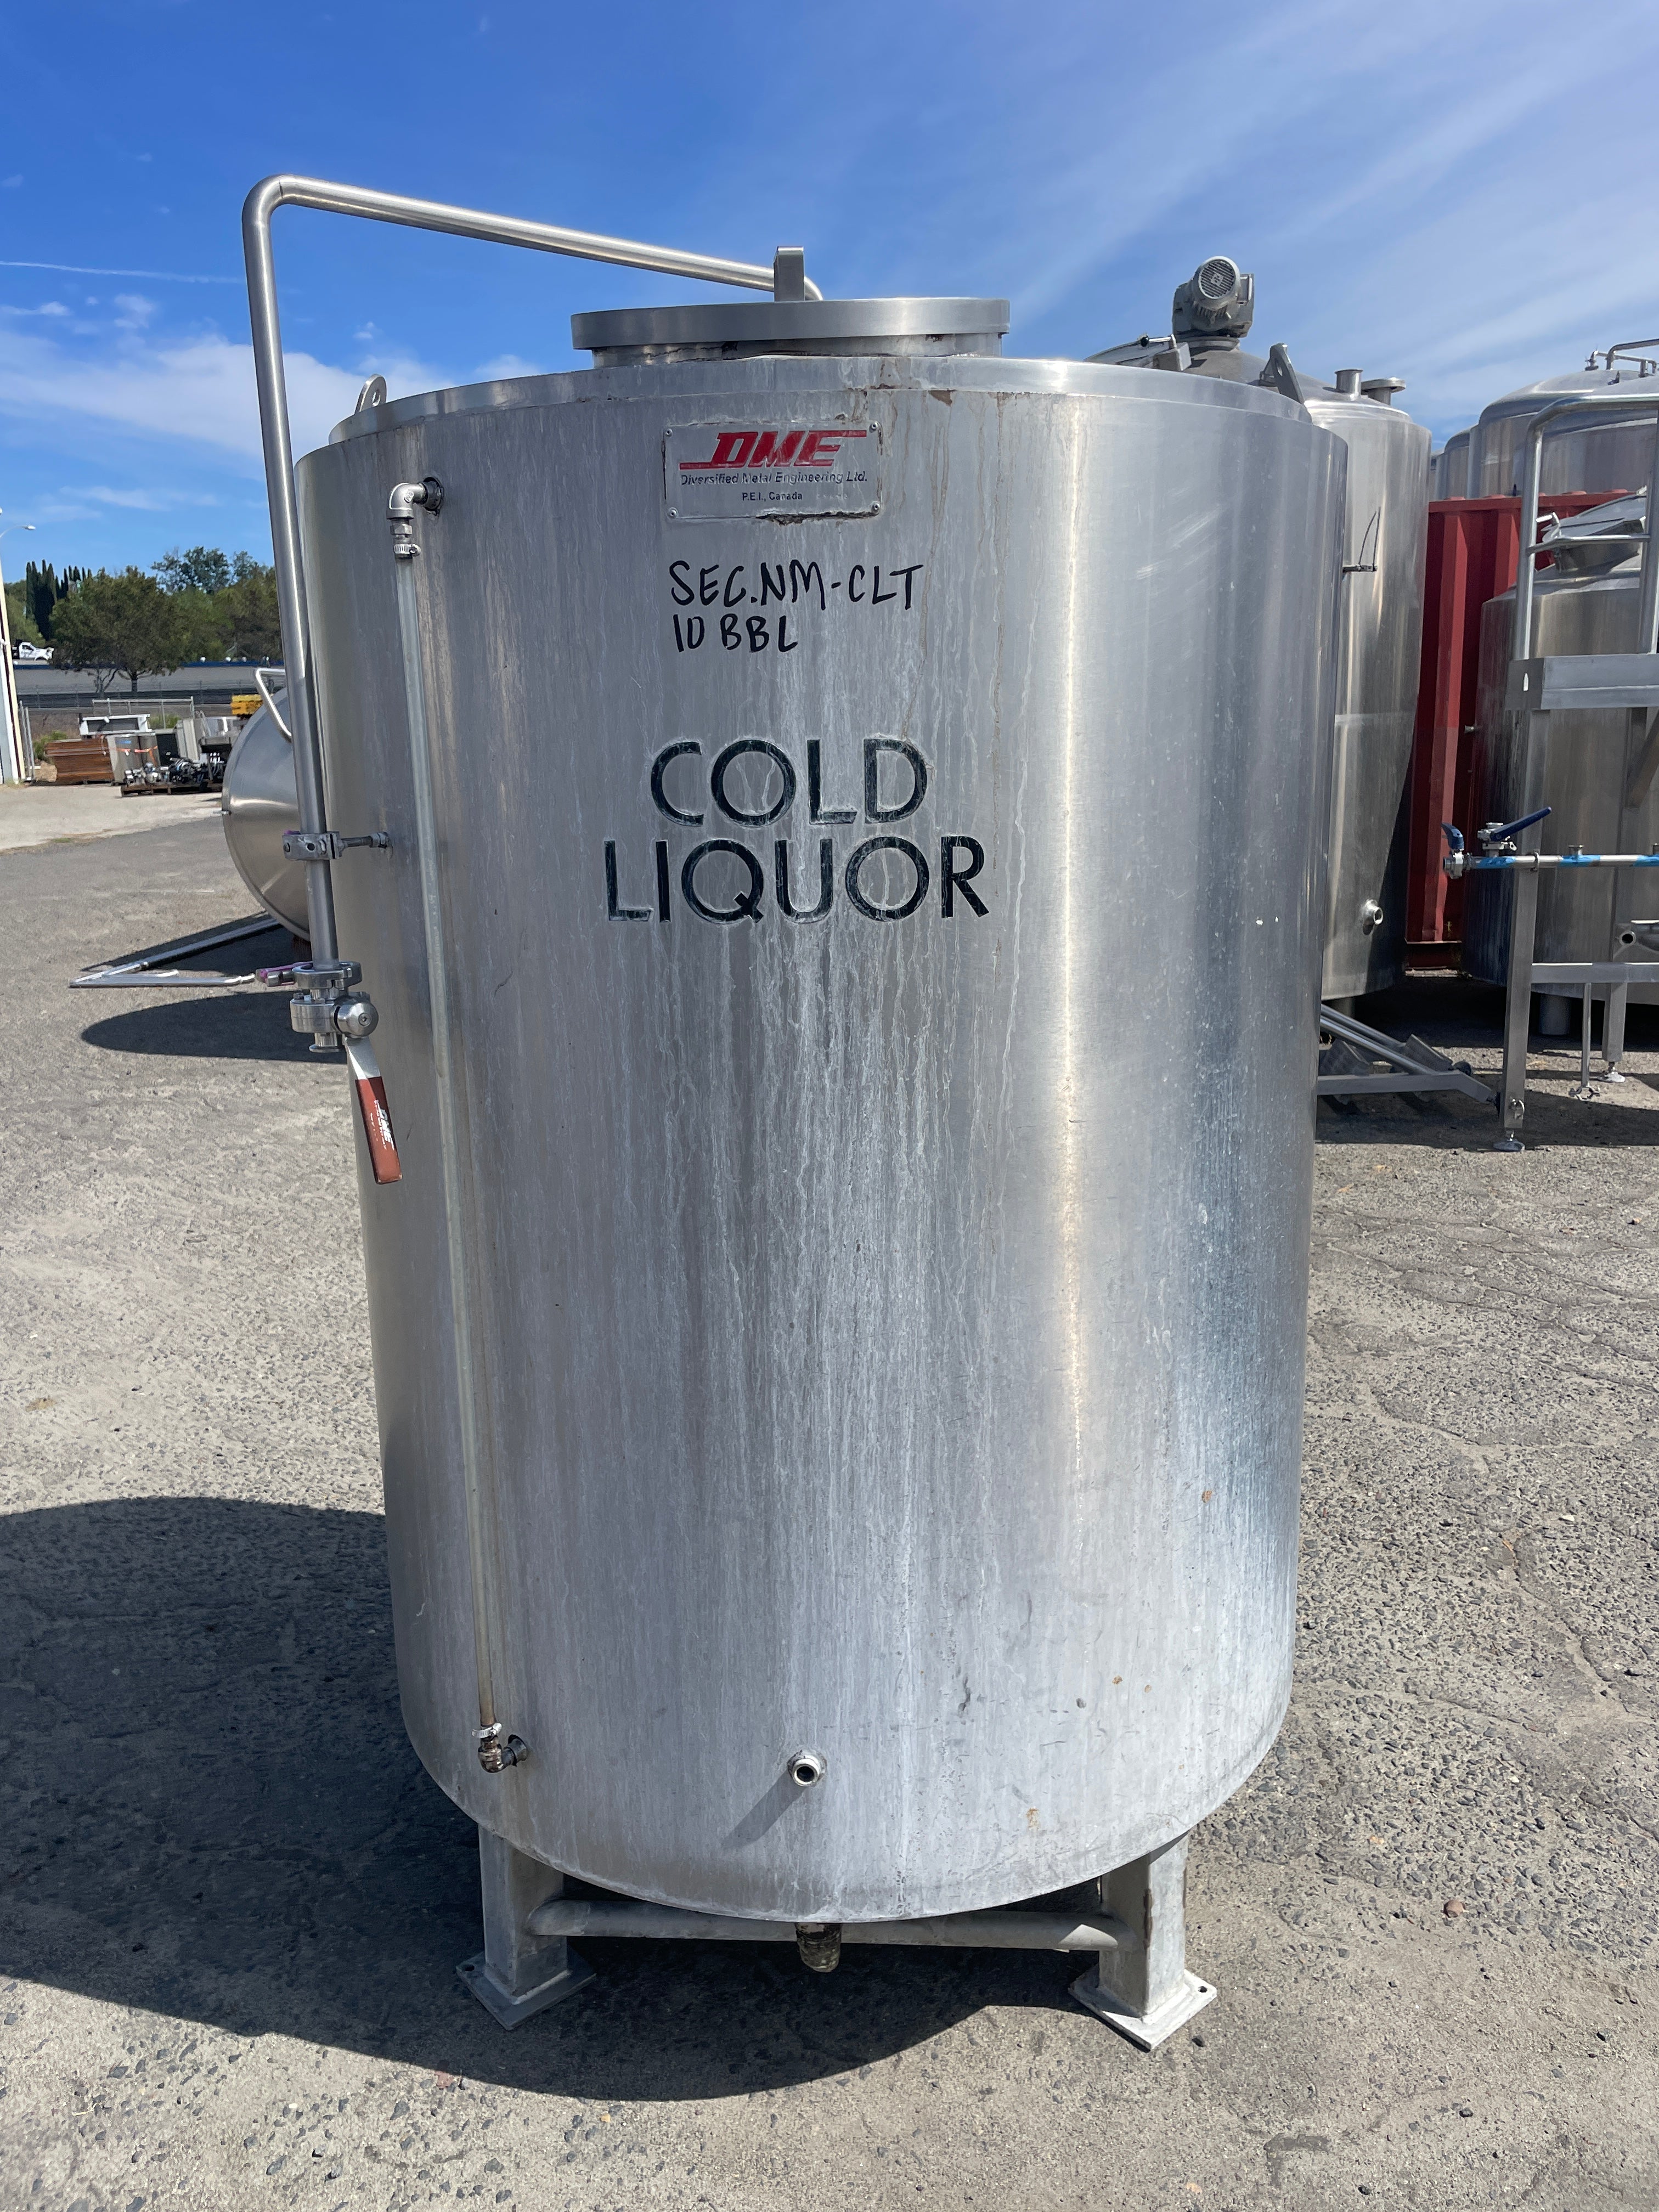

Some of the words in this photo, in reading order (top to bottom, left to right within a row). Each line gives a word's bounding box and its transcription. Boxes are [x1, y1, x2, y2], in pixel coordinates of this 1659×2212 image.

[679, 430, 866, 470] DME
[681, 473, 739, 485] Diversified
[742, 472, 772, 484] Metal
[775, 471, 843, 485] Engineering
[847, 471, 867, 482] Ltd.
[769, 491, 802, 500] Canada
[651, 739, 927, 827] COLD
[604, 836, 989, 924] LIQUOR
